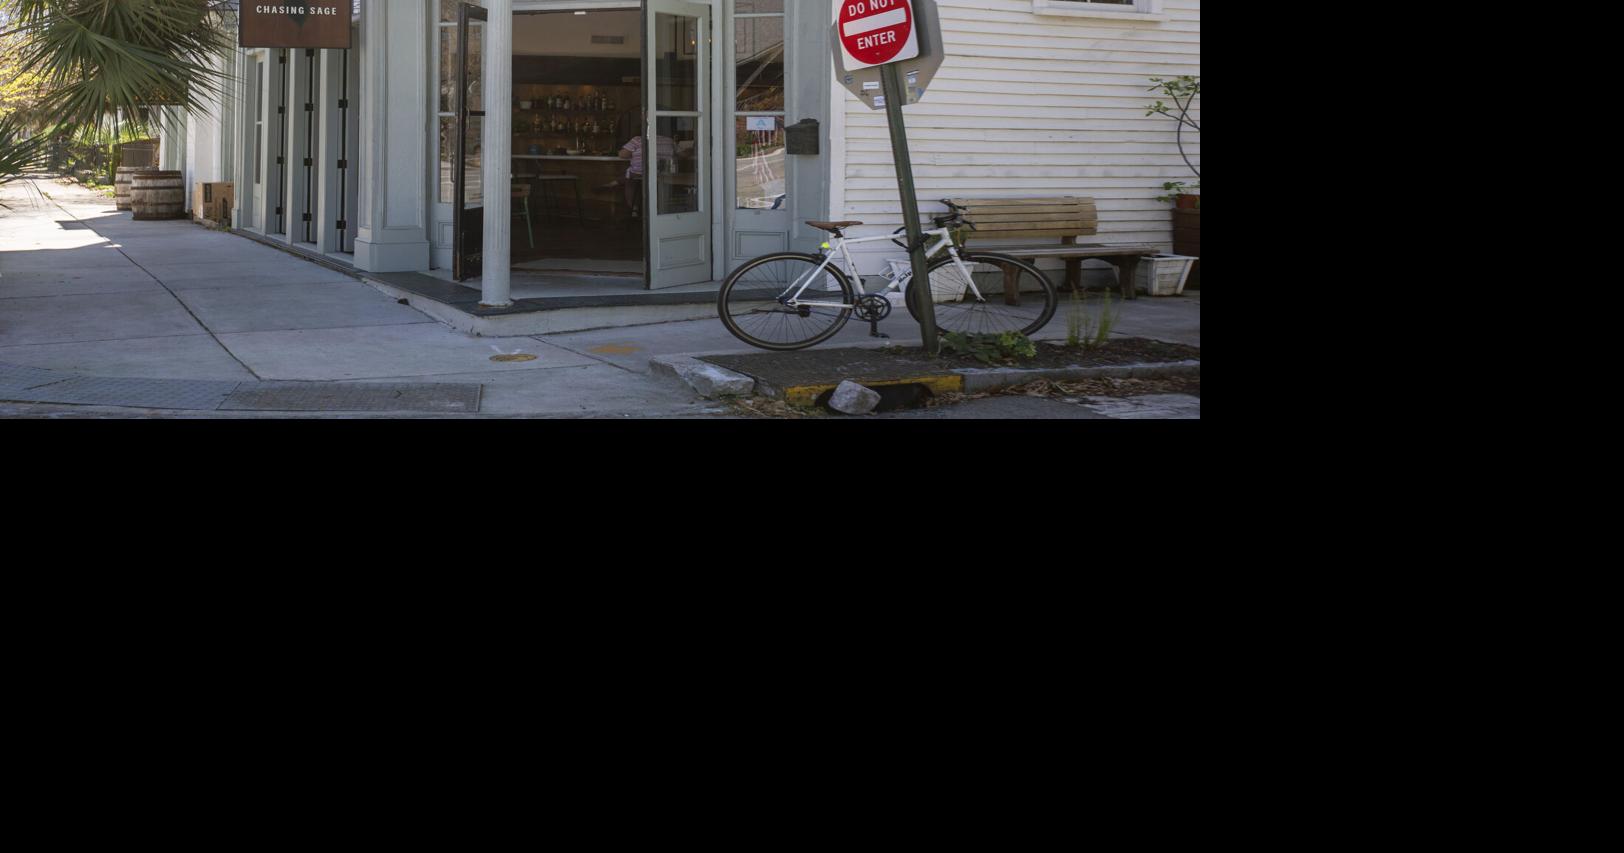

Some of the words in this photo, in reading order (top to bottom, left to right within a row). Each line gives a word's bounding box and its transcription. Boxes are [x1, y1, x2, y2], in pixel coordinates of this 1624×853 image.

[256, 5, 305, 15] CHASING
[310, 7, 337, 16] SAGE
[848, 2, 865, 17] DO
[857, 30, 896, 50] ENTER
